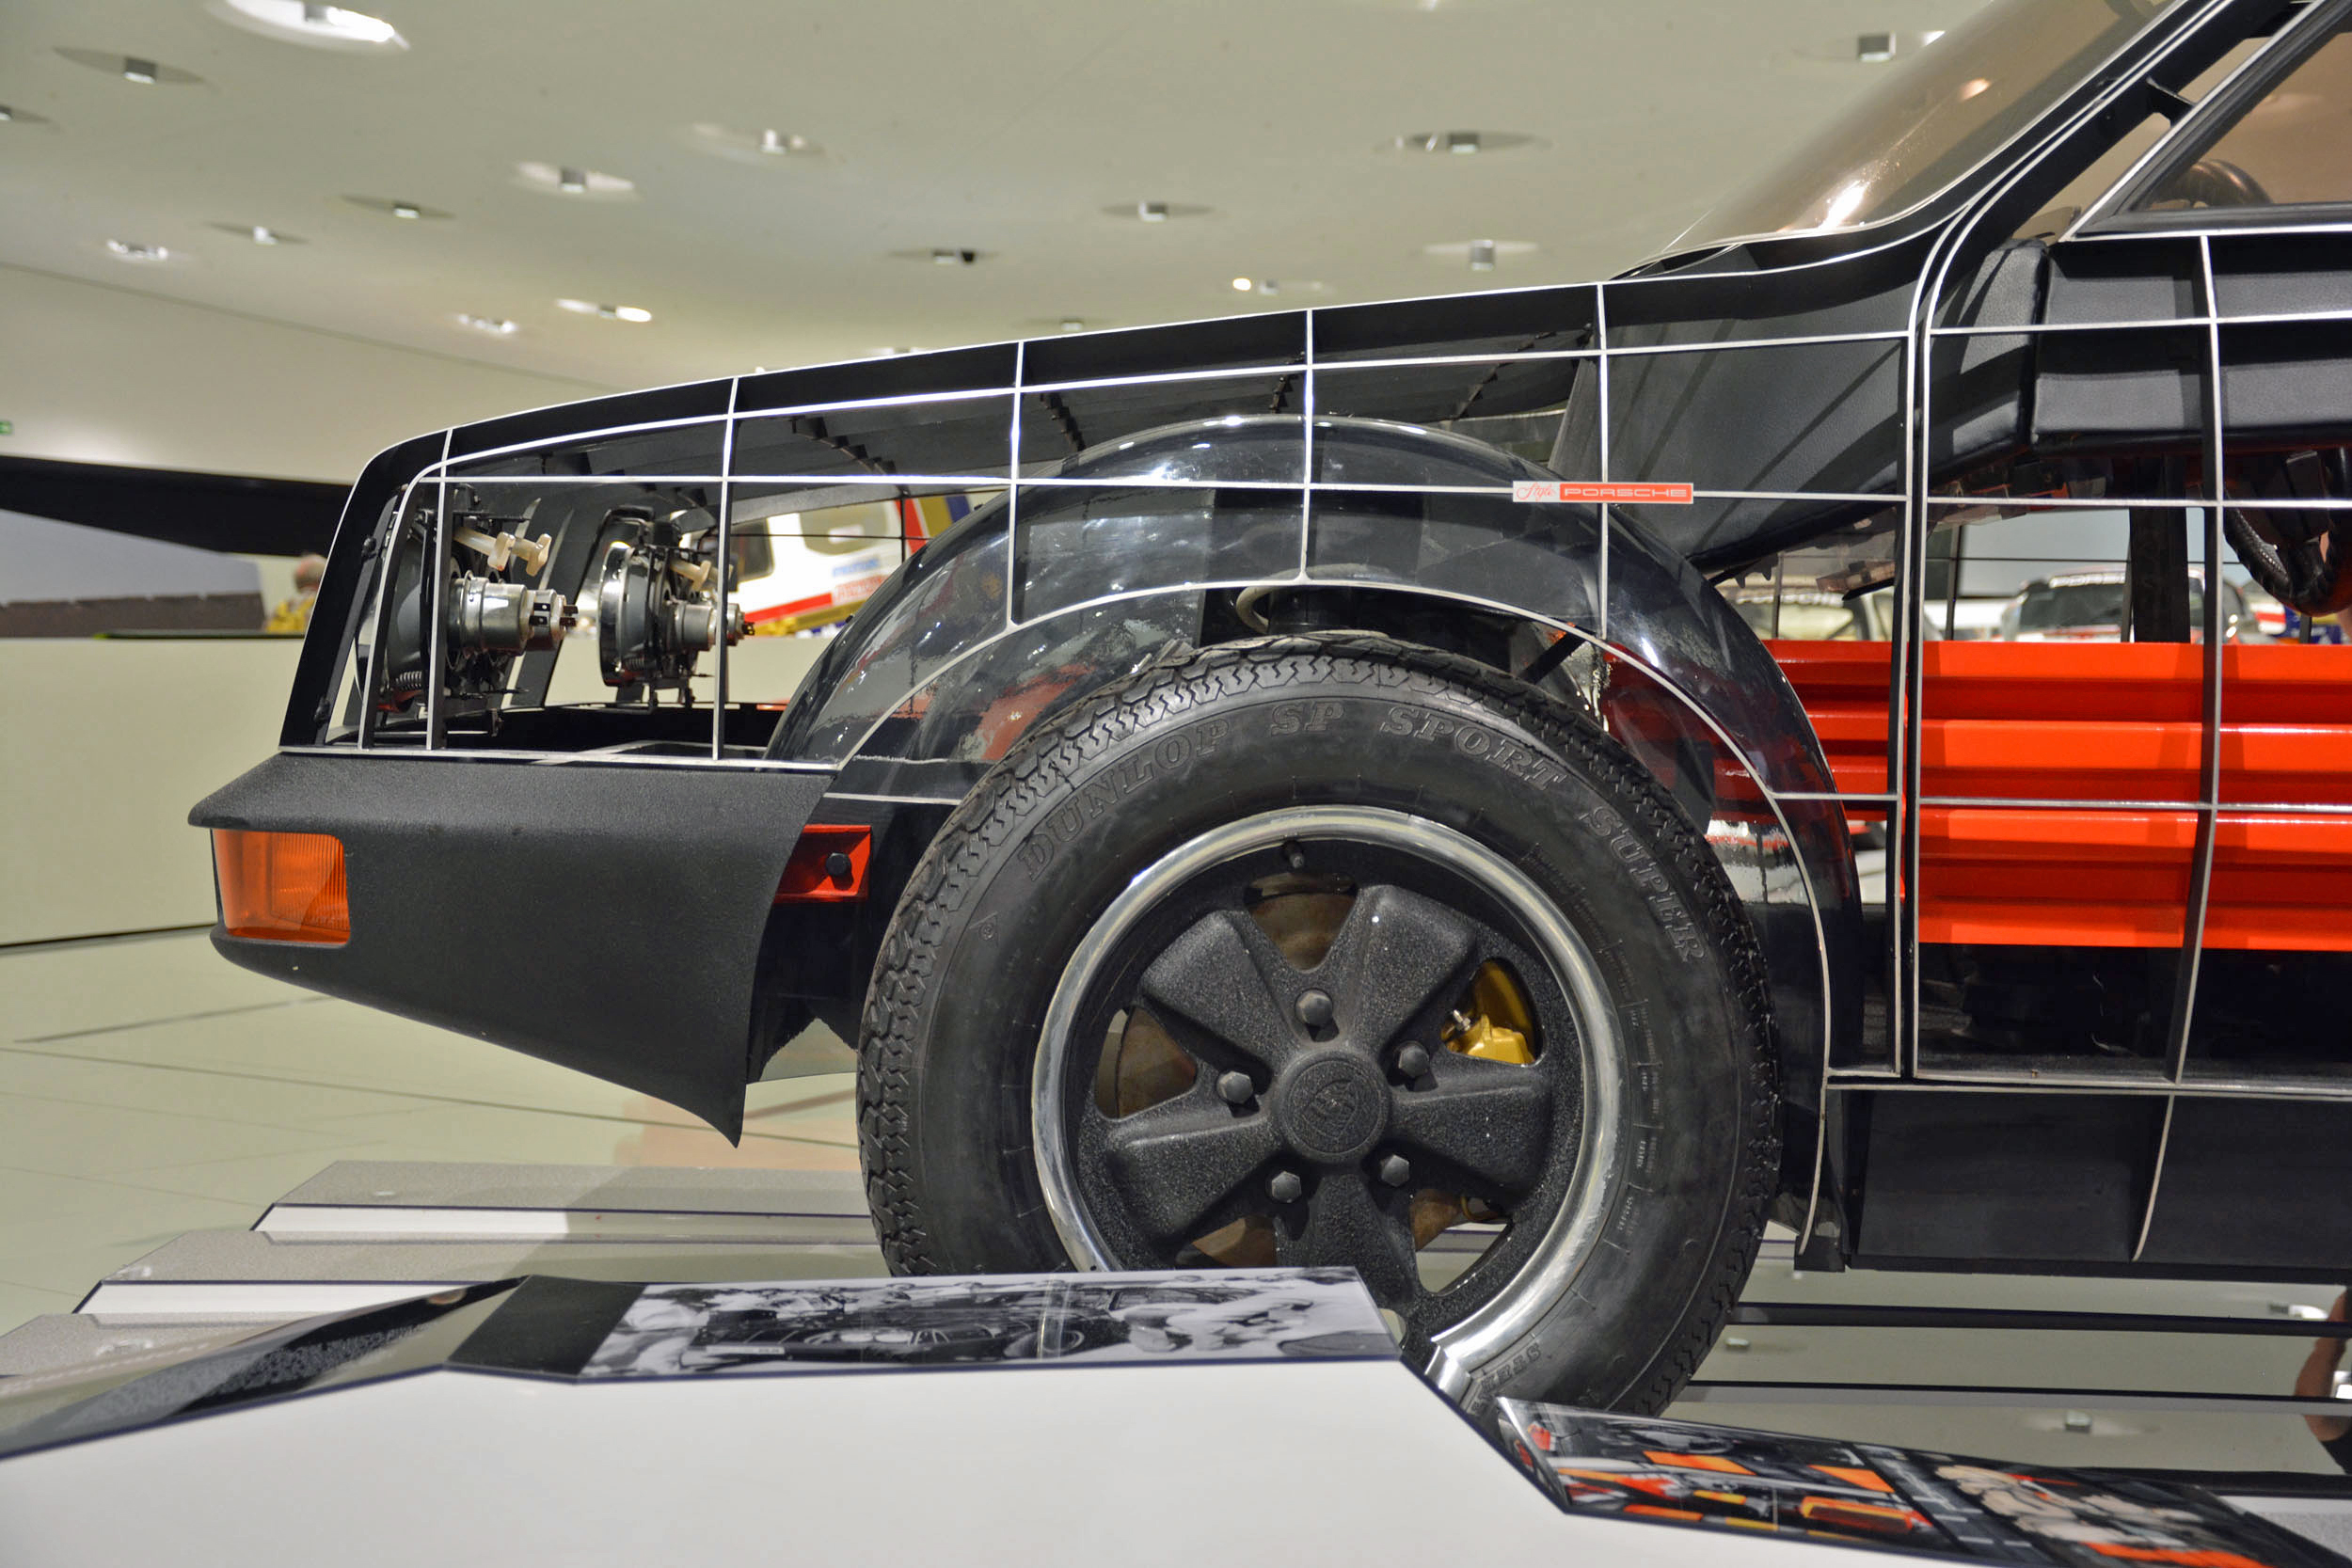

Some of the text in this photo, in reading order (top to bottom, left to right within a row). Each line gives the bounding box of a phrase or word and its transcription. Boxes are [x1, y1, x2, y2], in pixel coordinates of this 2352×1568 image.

[1564, 487, 1688, 499] PORSCHE
[1017, 717, 1230, 881] DUNLOP
[1271, 702, 1345, 736] SP
[1379, 705, 1568, 792] SPORT
[1578, 805, 1705, 962] SUPER
